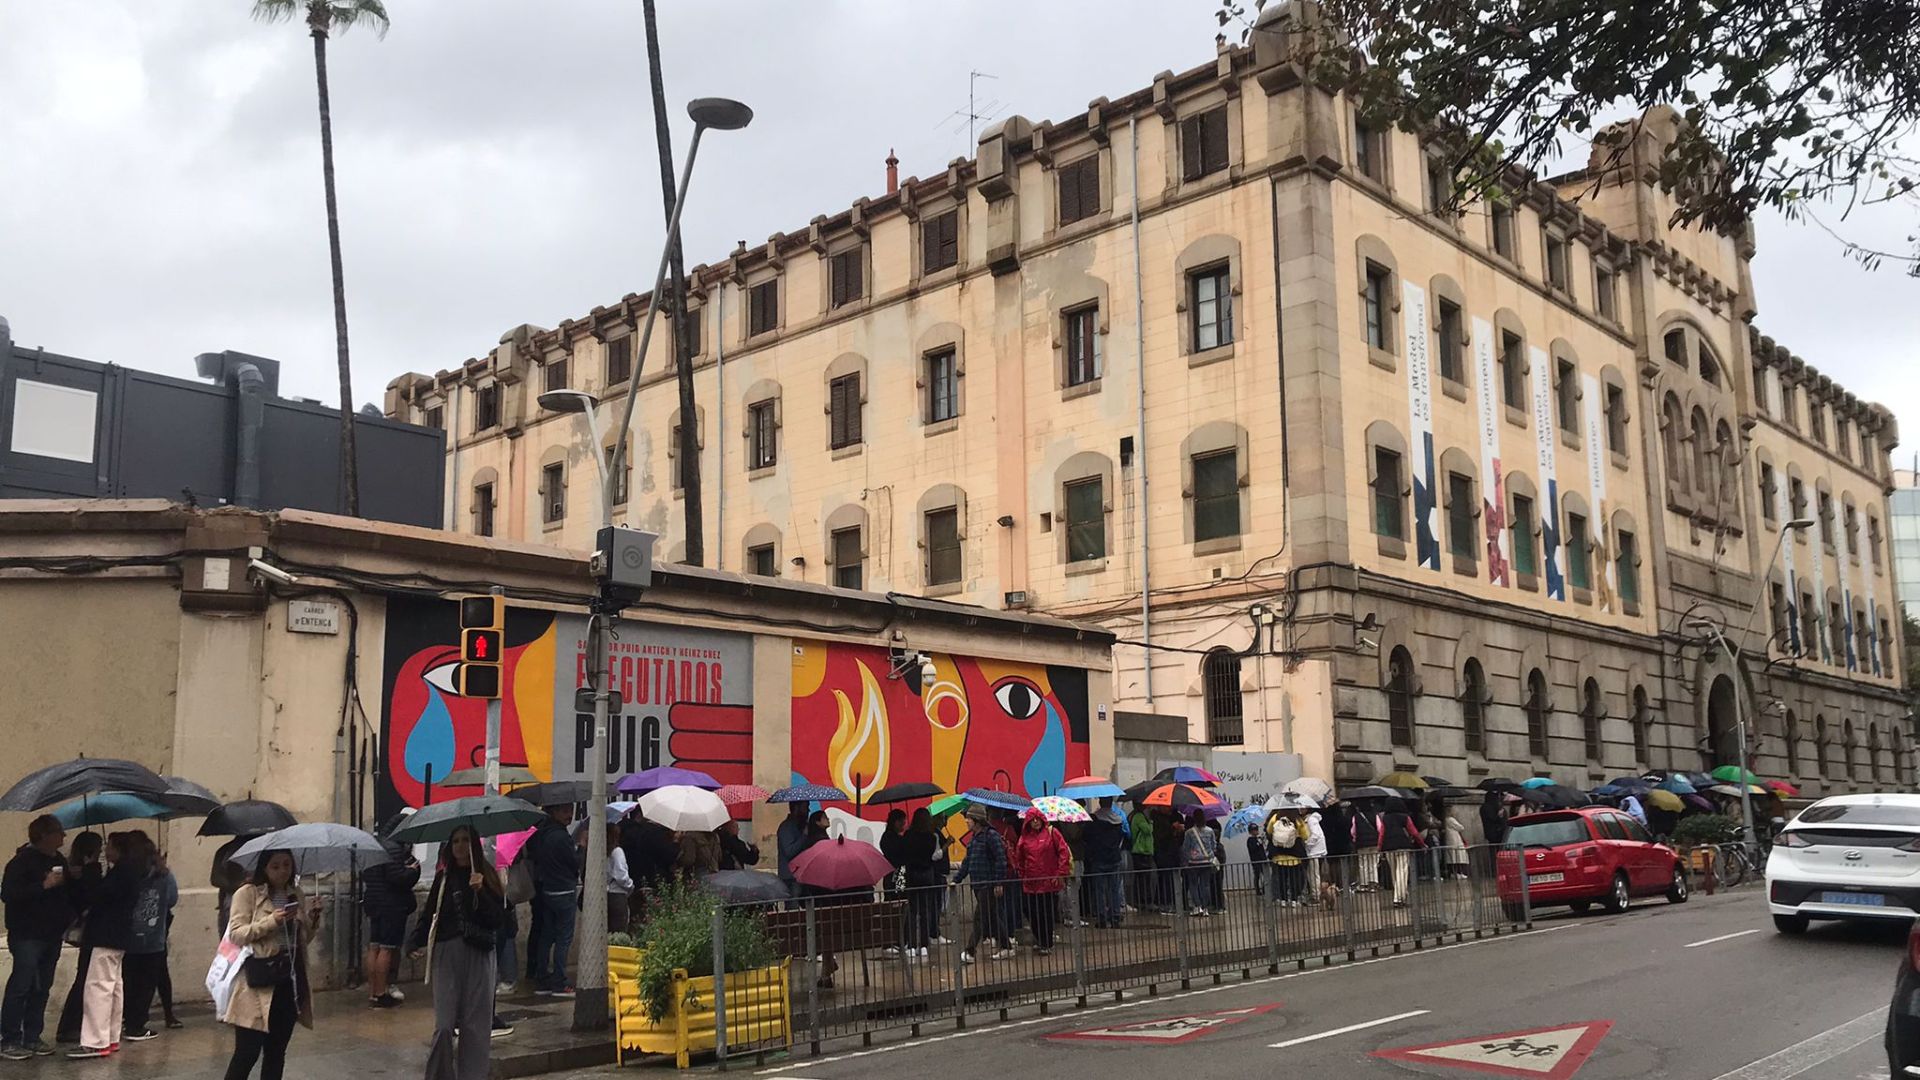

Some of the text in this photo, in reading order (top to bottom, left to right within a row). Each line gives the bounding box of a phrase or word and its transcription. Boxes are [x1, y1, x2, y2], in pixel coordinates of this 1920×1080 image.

[1408, 335, 1421, 418] La Model
[1416, 304, 1428, 396] transforma
[576, 653, 722, 705] EECUTADOS
[621, 643, 640, 653] PUIG
[642, 645, 671, 656] ANTICH
[672, 648, 677, 657] Y
[679, 648, 701, 659] HEINZ
[575, 713, 660, 774] PUIG
